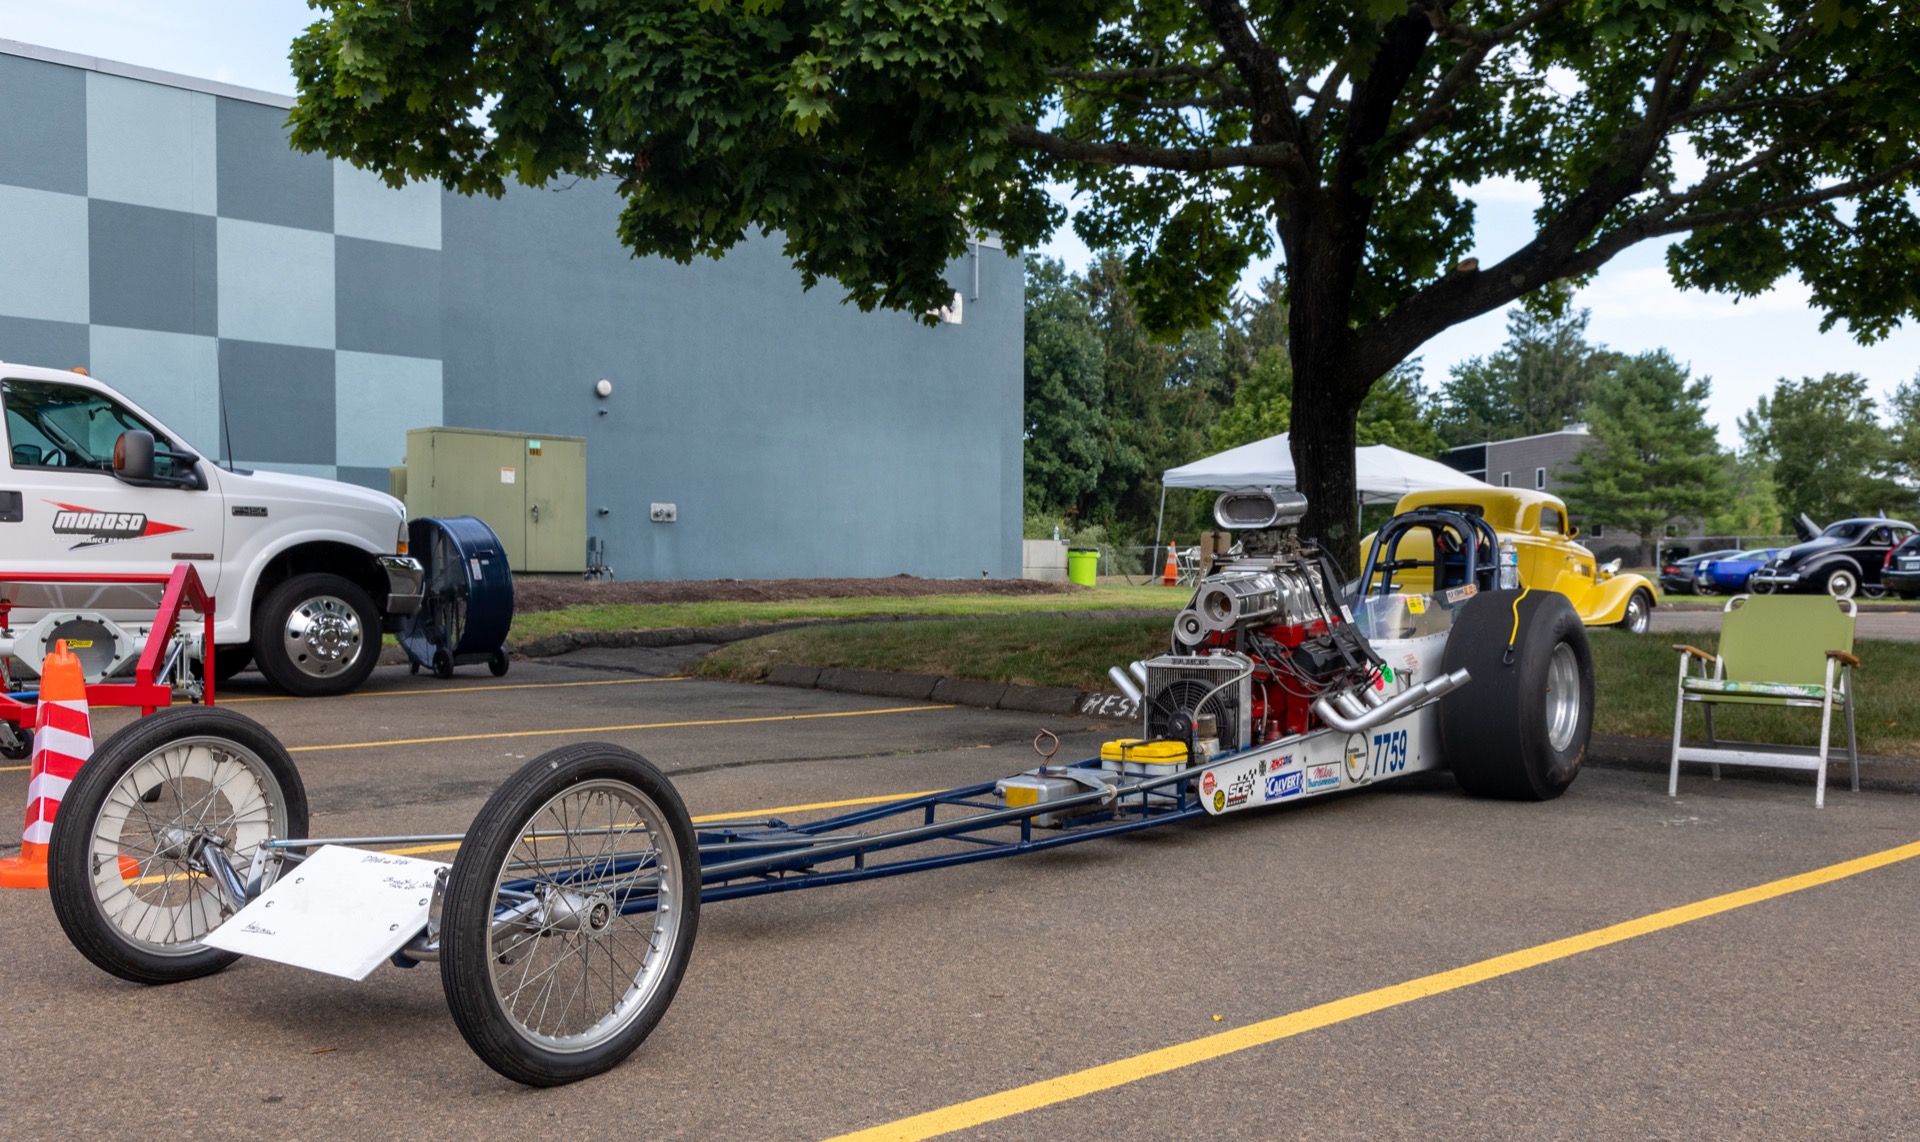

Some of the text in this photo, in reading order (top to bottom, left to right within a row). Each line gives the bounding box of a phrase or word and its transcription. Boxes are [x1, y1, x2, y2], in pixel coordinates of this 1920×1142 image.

[54, 512, 144, 530] MOROSO
[1171, 658, 1210, 666] BUICK
[1374, 729, 1407, 777] 7759
[1228, 782, 1250, 799] SCE
[1267, 772, 1301, 796] CALVERT
